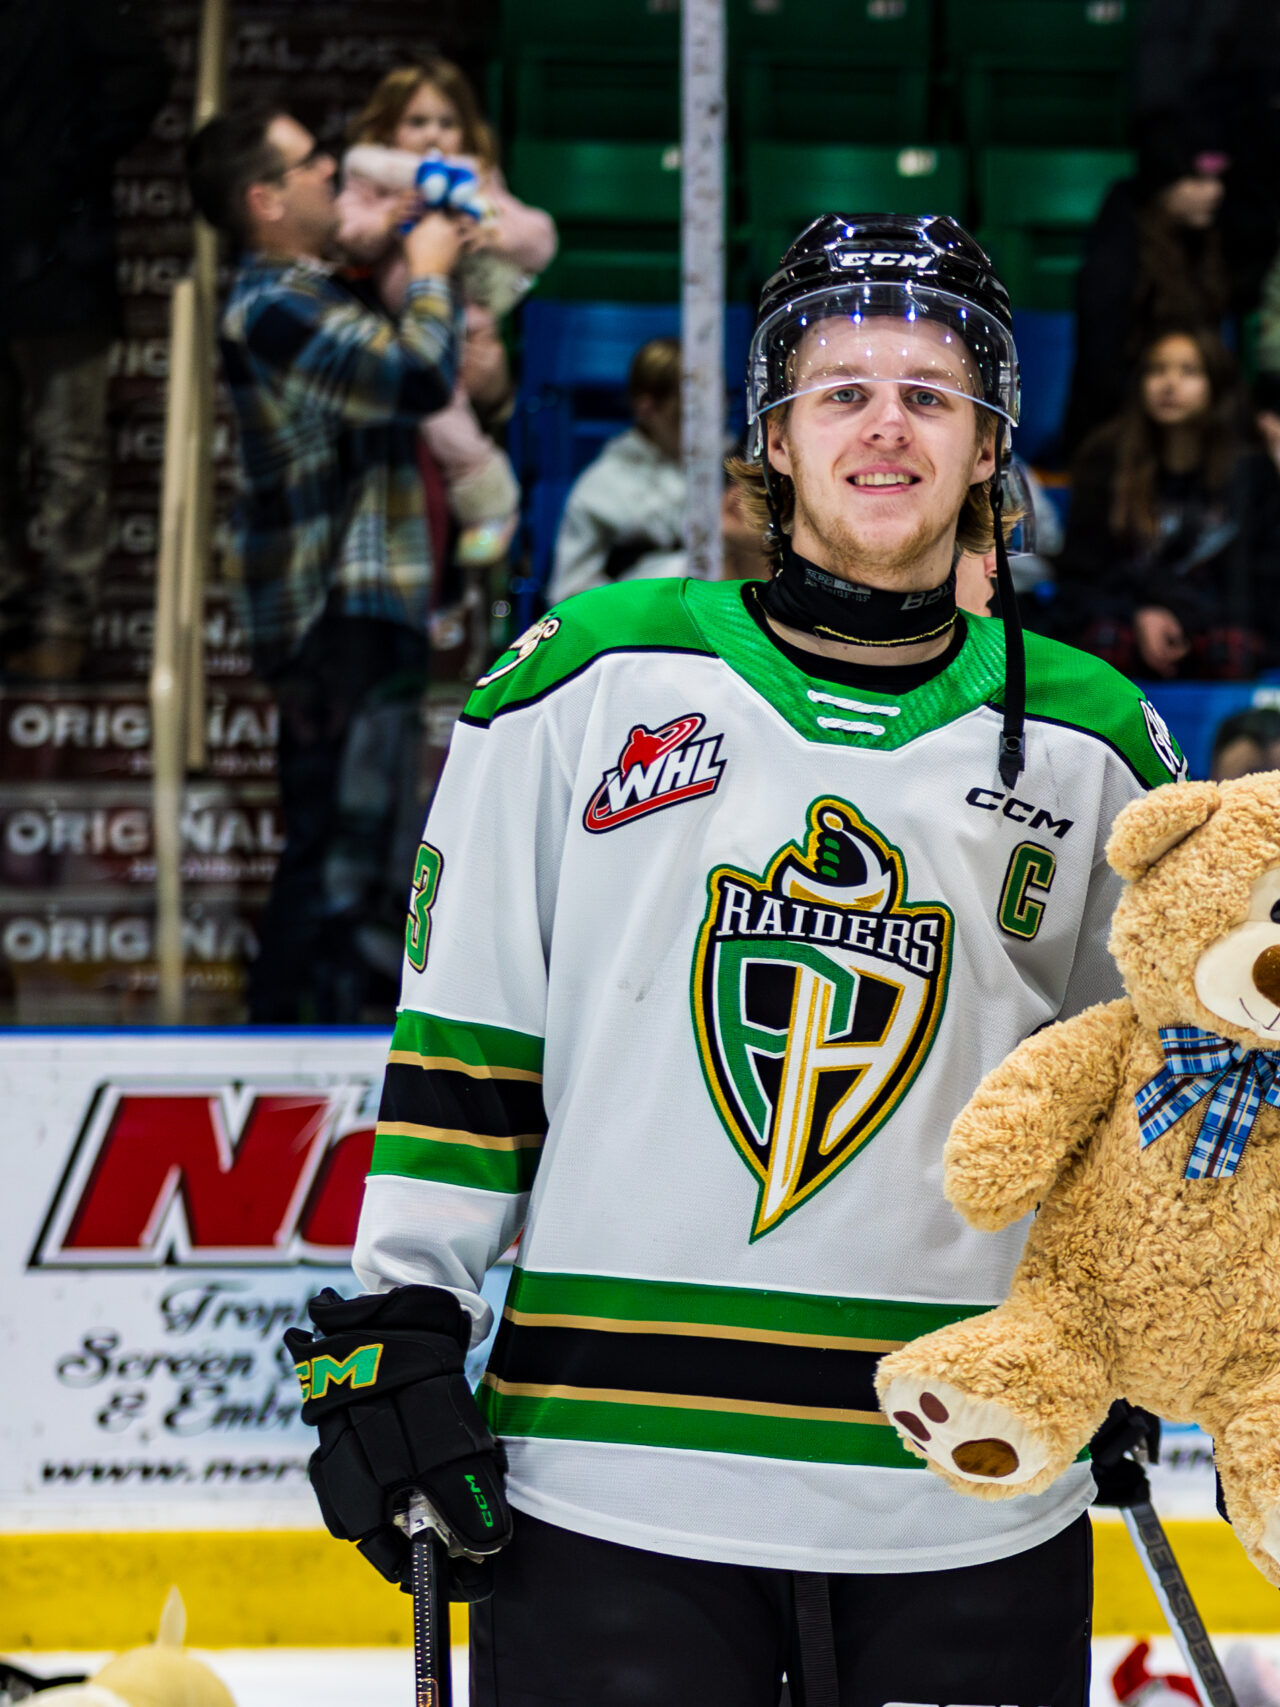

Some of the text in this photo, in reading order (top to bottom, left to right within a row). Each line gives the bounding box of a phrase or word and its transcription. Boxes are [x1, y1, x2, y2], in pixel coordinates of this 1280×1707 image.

[840, 252, 932, 268] CCM
[602, 733, 727, 814] WHL
[7, 810, 287, 855] ORIGNAL
[965, 787, 1074, 839] CCM
[405, 841, 444, 974] 3
[997, 840, 1057, 942] C
[716, 881, 939, 974] RAIDERS
[56, 1327, 256, 1388] Screen
[163, 1381, 301, 1437] Embr
[42, 1455, 311, 1482] www.nor
[464, 1474, 494, 1528] CCM
